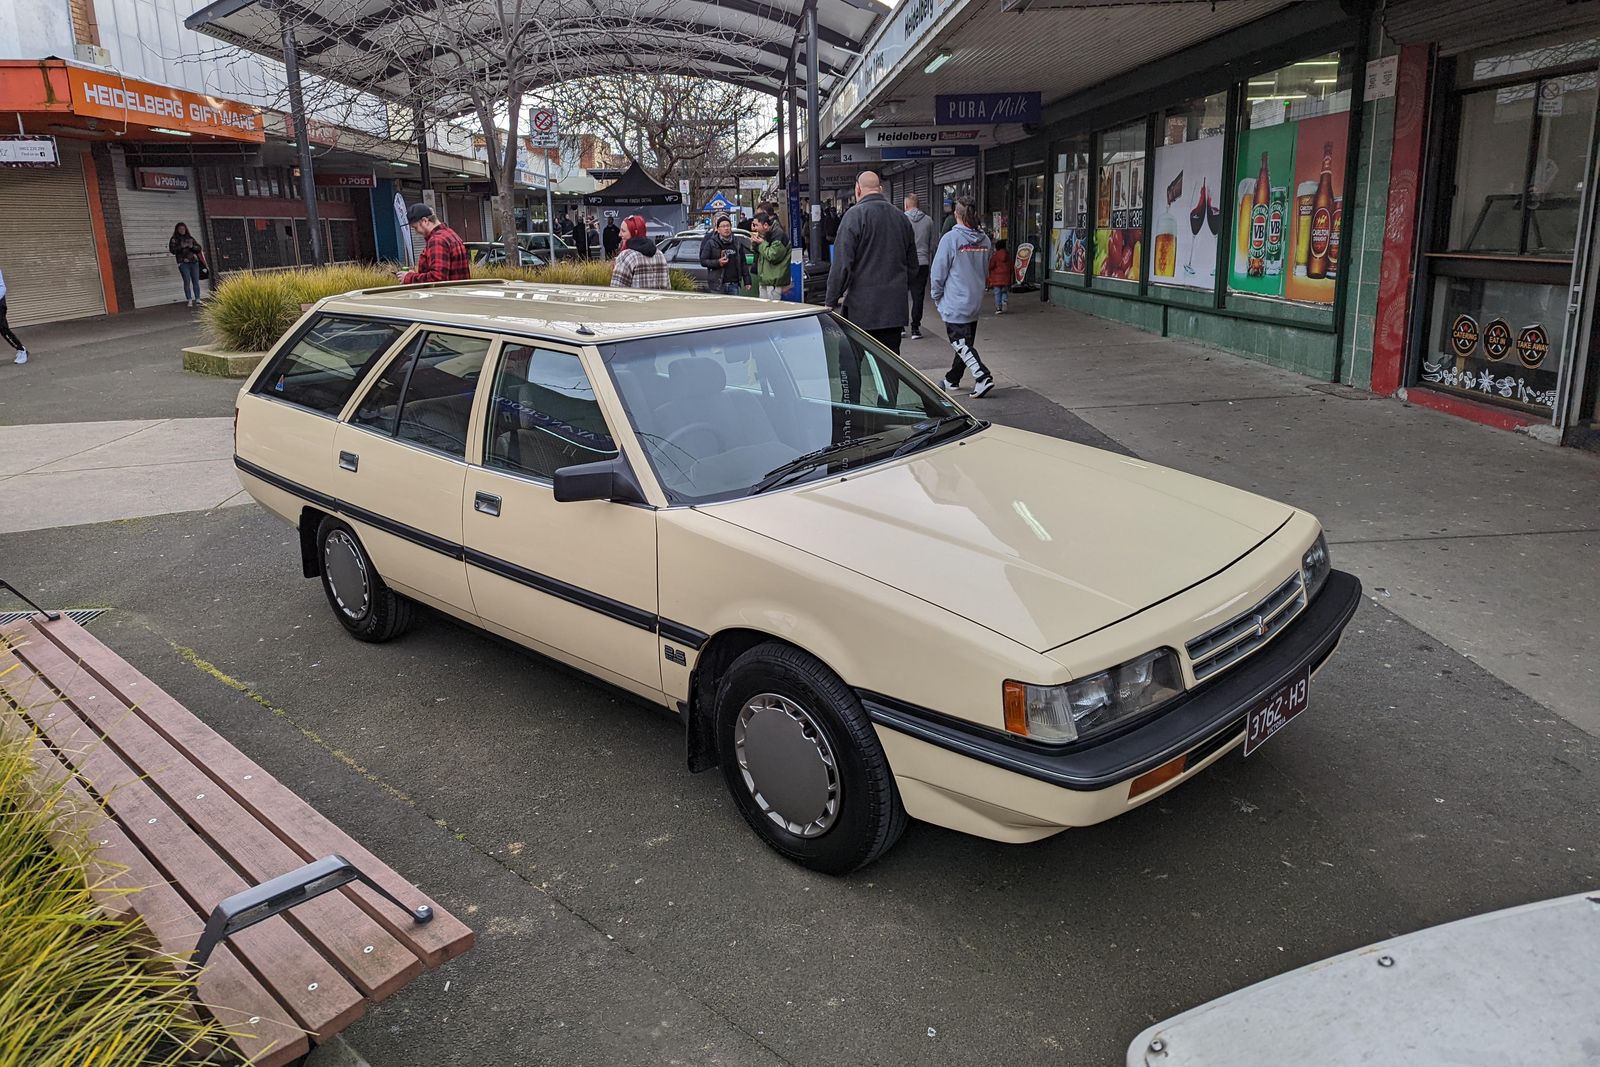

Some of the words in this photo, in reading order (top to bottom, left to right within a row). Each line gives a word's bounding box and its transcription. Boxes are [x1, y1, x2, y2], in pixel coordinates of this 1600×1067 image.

[83, 81, 184, 119] HEIDELBERG
[189, 103, 256, 131] GIFTWARE
[949, 100, 987, 118] PURA
[990, 95, 1028, 121] Milk
[877, 131, 938, 142] Heidelberg
[843, 154, 853, 162] 34
[348, 177, 371, 185] POST
[1254, 225, 1265, 239] VB
[1270, 219, 1280, 234] VB
[1453, 330, 1478, 342] CATERING
[1489, 336, 1500, 344] EAT
[1517, 340, 1531, 350] TAKE
[1531, 342, 1549, 352] AWAY
[1267, 716, 1286, 735] VICTORIA
